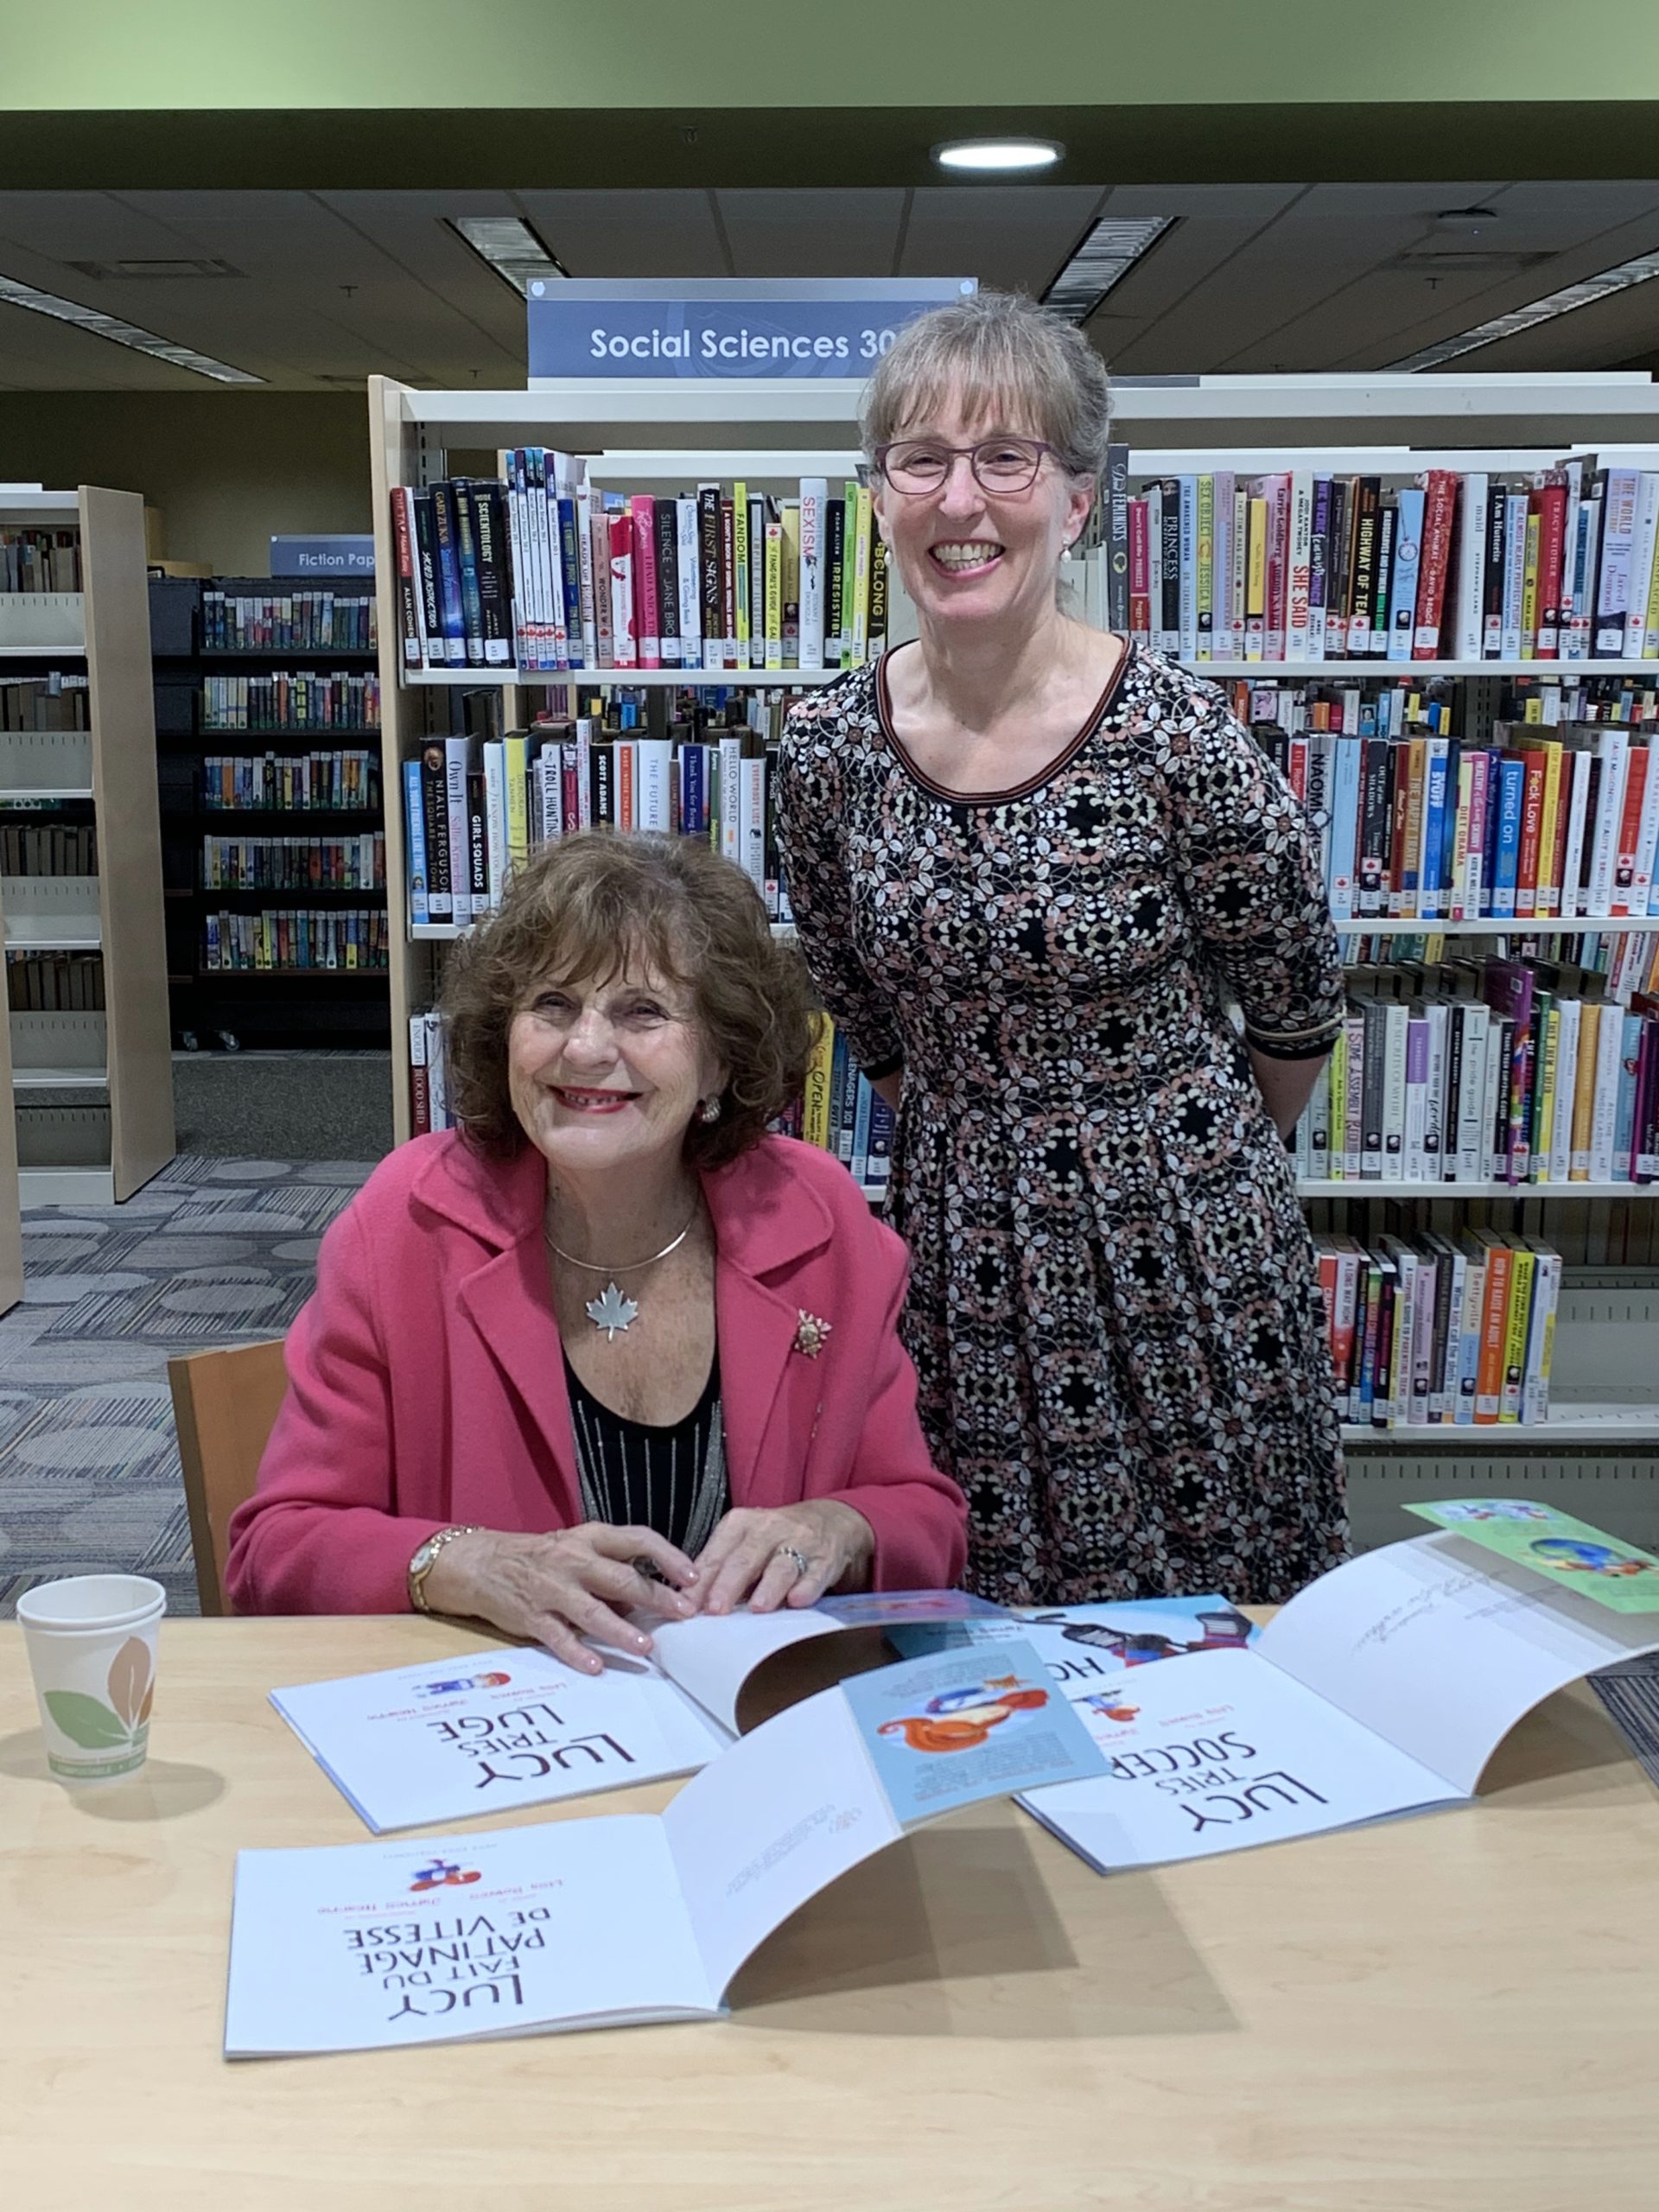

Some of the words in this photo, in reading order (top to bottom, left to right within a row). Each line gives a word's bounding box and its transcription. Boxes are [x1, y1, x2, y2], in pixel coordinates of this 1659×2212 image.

[590, 329, 690, 359] Social
[701, 329, 849, 359] Sciences
[704, 493, 715, 512] THE
[1200, 481, 1211, 499] SEX
[1437, 480, 1446, 494] THE
[1621, 478, 1636, 496] THE
[435, 492, 445, 517] GARY
[1113, 493, 1128, 542] FEMINISTS
[1200, 502, 1211, 537] OBJECT
[1434, 498, 1444, 525] SOCIAL
[1475, 505, 1484, 532] maid
[1495, 500, 1503, 518] Am
[1618, 499, 1634, 534] WORLD
[478, 503, 493, 563] SCIENTOLOGY
[661, 514, 672, 563] SILENCE
[704, 514, 717, 557] FIRST
[737, 513, 746, 563] FANDOM
[802, 497, 816, 557] SEXISM
[1274, 518, 1284, 557] Goldberg
[1493, 521, 1503, 563] Hutterite
[1167, 516, 1179, 580] PRINCESS
[1358, 518, 1374, 570] HIGHWAY
[299, 554, 345, 566] Fiction
[664, 579, 674, 608] JANE
[705, 560, 719, 604] SIGNS
[1200, 562, 1211, 596] JESSICA
[1293, 565, 1308, 591] SHE
[1357, 575, 1371, 588] OF
[1427, 570, 1437, 594] DAVID
[1604, 565, 1617, 612] Diamond
[404, 588, 413, 609] ALAN
[831, 562, 842, 638] IRRESISTIBL
[1292, 597, 1307, 628] SAID
[406, 610, 415, 638] COHEN
[448, 760, 462, 791] Own
[544, 764, 556, 793] TROLL
[599, 754, 607, 781] SCOTT
[649, 760, 658, 778] THE
[728, 747, 738, 779] HELLO
[435, 780, 445, 817] NIALL
[599, 784, 607, 815] ADAMS
[649, 785, 658, 826] FUTURE
[728, 784, 738, 823] WORLD
[1503, 772, 1517, 819] turned
[472, 816, 481, 841] GIRL
[752, 808, 760, 824] LIES
[1459, 806, 1468, 826] DIET
[1526, 803, 1540, 833] Love
[1456, 830, 1466, 867] DRAMA
[1502, 825, 1513, 843] on
[437, 824, 448, 894] FERGUSON
[473, 842, 484, 887] SQUADS
[1349, 1033, 1363, 1061] SOME
[1469, 1060, 1480, 1084] pride
[1348, 1069, 1362, 1114] ASSEMBLY
[1467, 1089, 1479, 1116] guide
[1470, 1273, 1483, 1328] Bettyville
[427, 1704, 565, 1742] LUGE
[457, 1731, 558, 1758] TRIES
[475, 1734, 637, 1789] LUCY
[1155, 1766, 1246, 1796] TRIES
[1179, 1770, 1330, 1833] LUCY
[343, 1916, 495, 1950] VITESSE
[508, 1908, 550, 1928] DE
[355, 1928, 545, 1976] PATINAGE
[447, 1955, 519, 1980] FAIT
[383, 1971, 432, 1990] DU
[388, 1974, 523, 2022] LUCY
